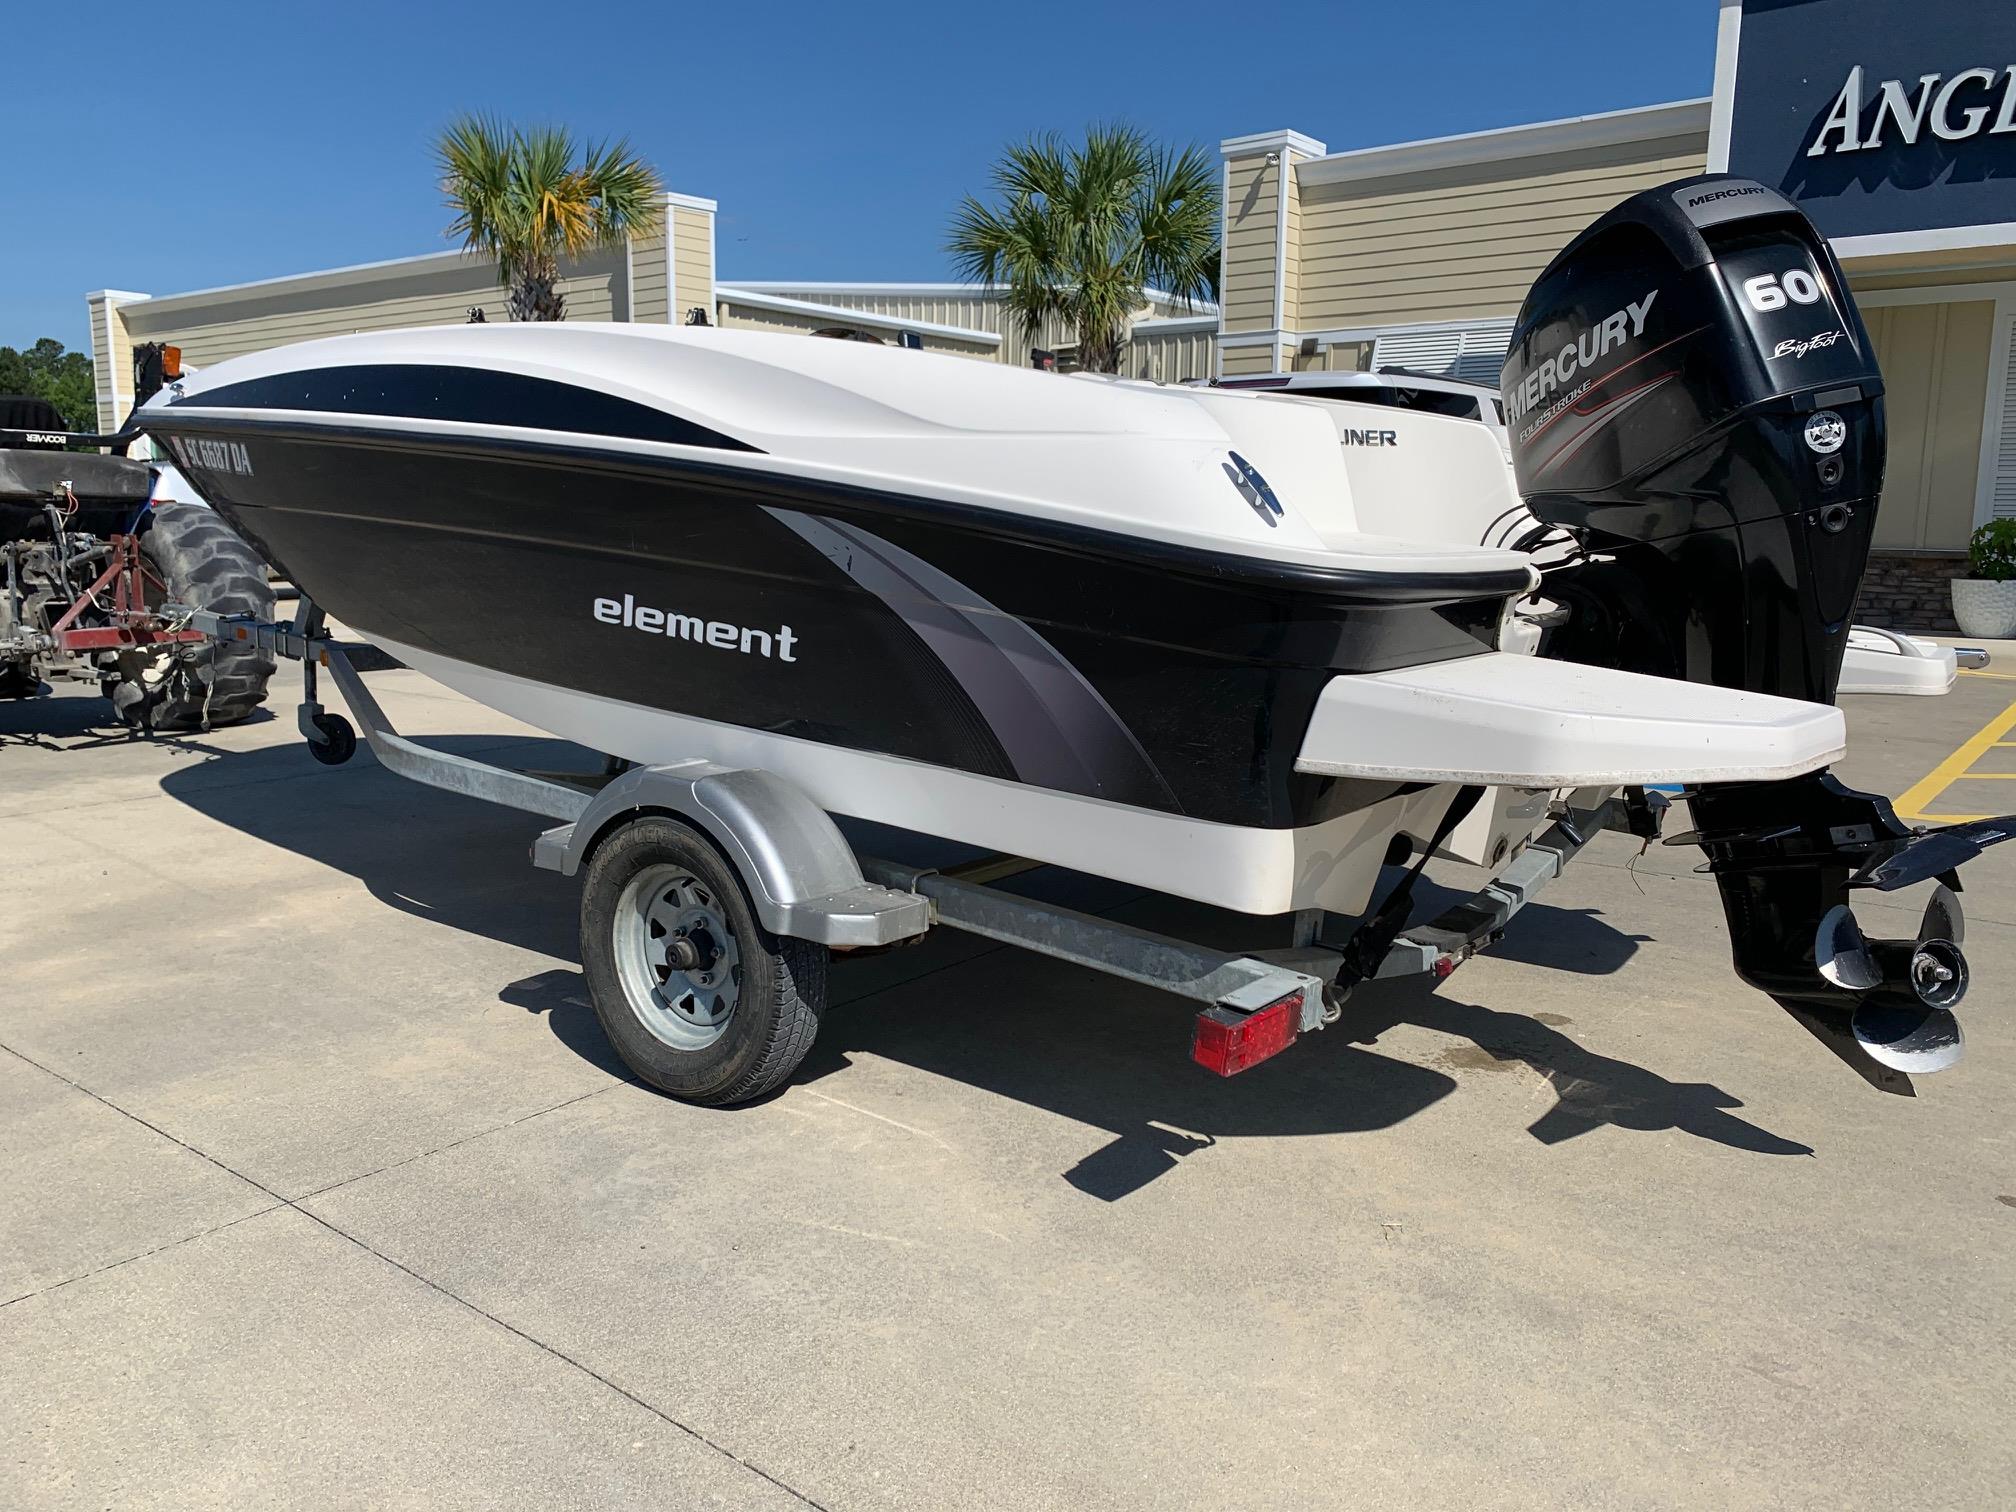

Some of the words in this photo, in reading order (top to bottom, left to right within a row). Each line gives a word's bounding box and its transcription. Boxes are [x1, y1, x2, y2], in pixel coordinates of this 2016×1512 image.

[1688, 187, 1766, 207] MERCURY
[1742, 268, 1822, 313] 60
[1510, 289, 1659, 423] MERCURY
[1519, 379, 1593, 443] FOURSTROKE
[26, 433, 67, 444] BOOMER
[184, 438, 203, 466] SC
[198, 440, 231, 471] 6687
[229, 442, 255, 477] DA
[1340, 428, 1398, 447] INER
[593, 593, 799, 663] element
